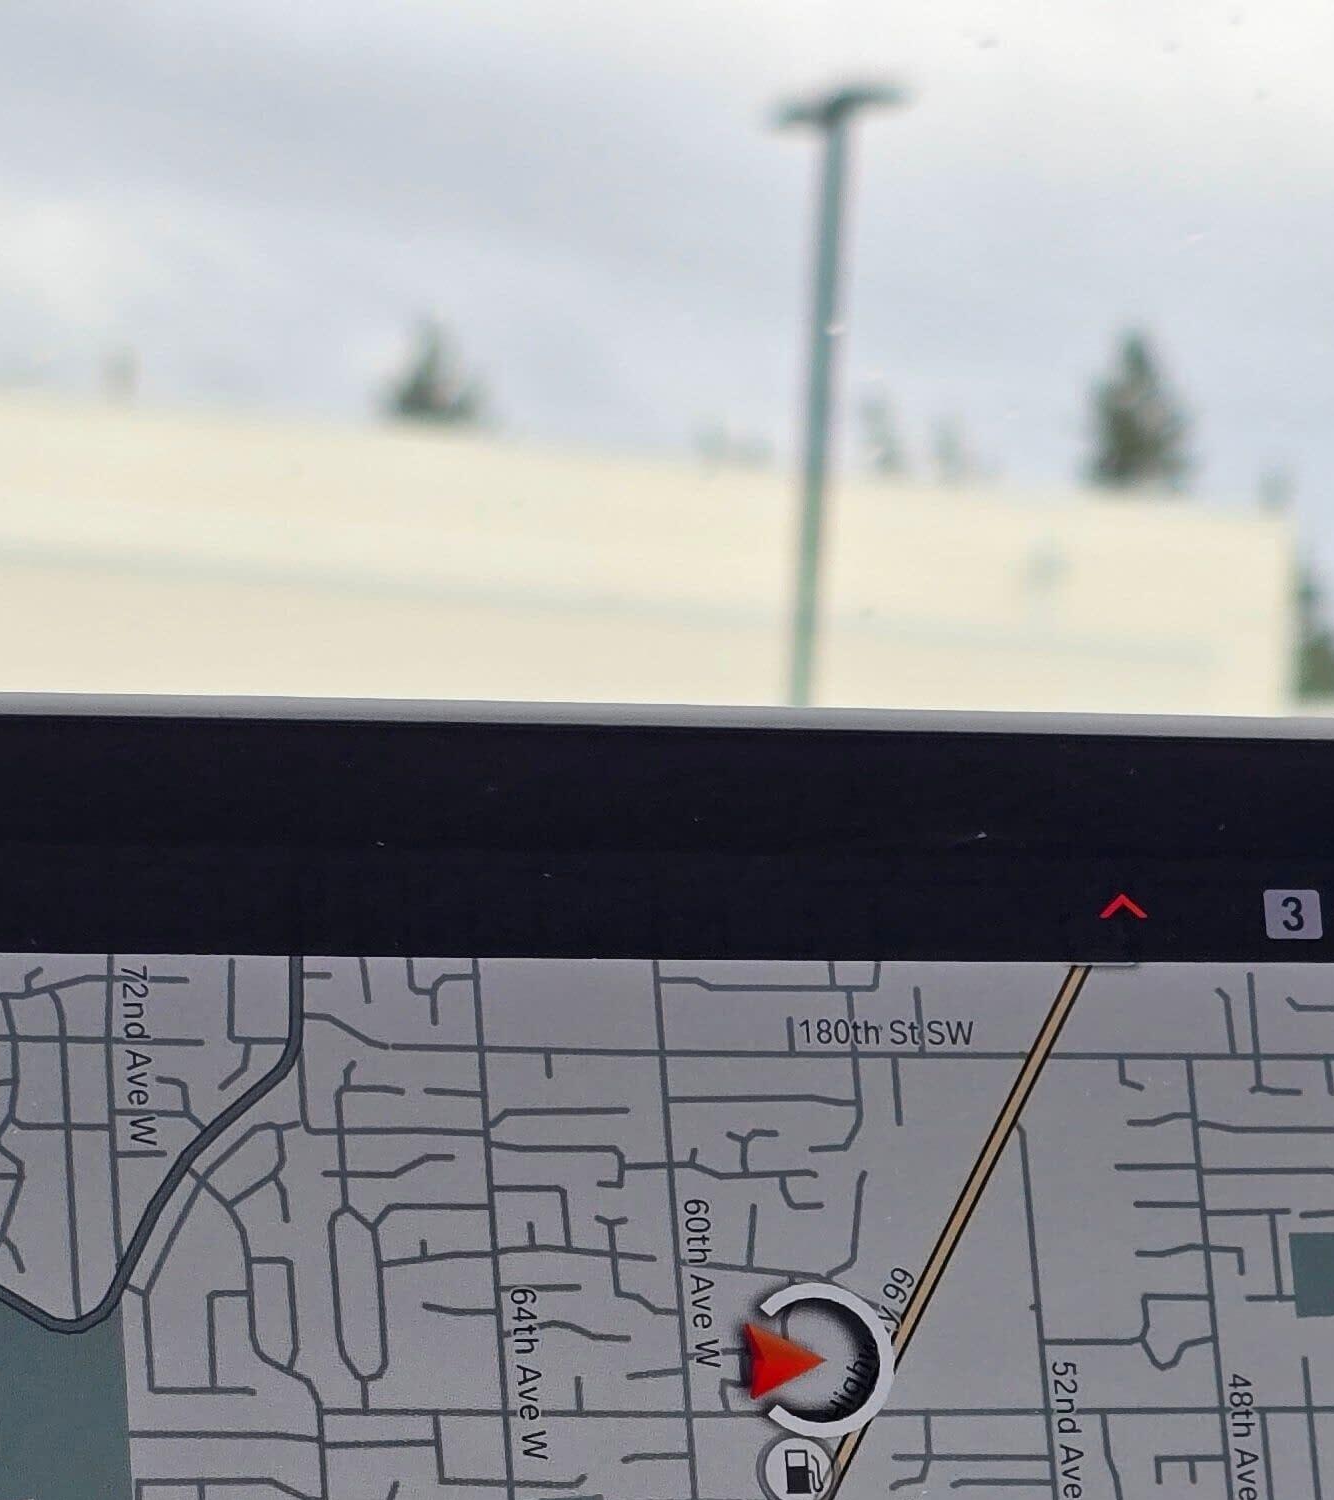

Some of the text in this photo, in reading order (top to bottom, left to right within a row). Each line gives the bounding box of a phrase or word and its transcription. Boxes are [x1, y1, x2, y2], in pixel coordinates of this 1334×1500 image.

[1281, 896, 1305, 931] 3
[121, 965, 157, 1146] 72nd Ave W
[799, 1018, 974, 1045] 180th St SW
[684, 1198, 721, 1368] 60th Ave W
[882, 1267, 914, 1304] 99
[510, 1288, 548, 1460] 64th Ave W
[1052, 1362, 1082, 1433] 52nd
[1228, 1373, 1255, 1437] 48th
[1059, 1443, 1084, 1499] Ave
